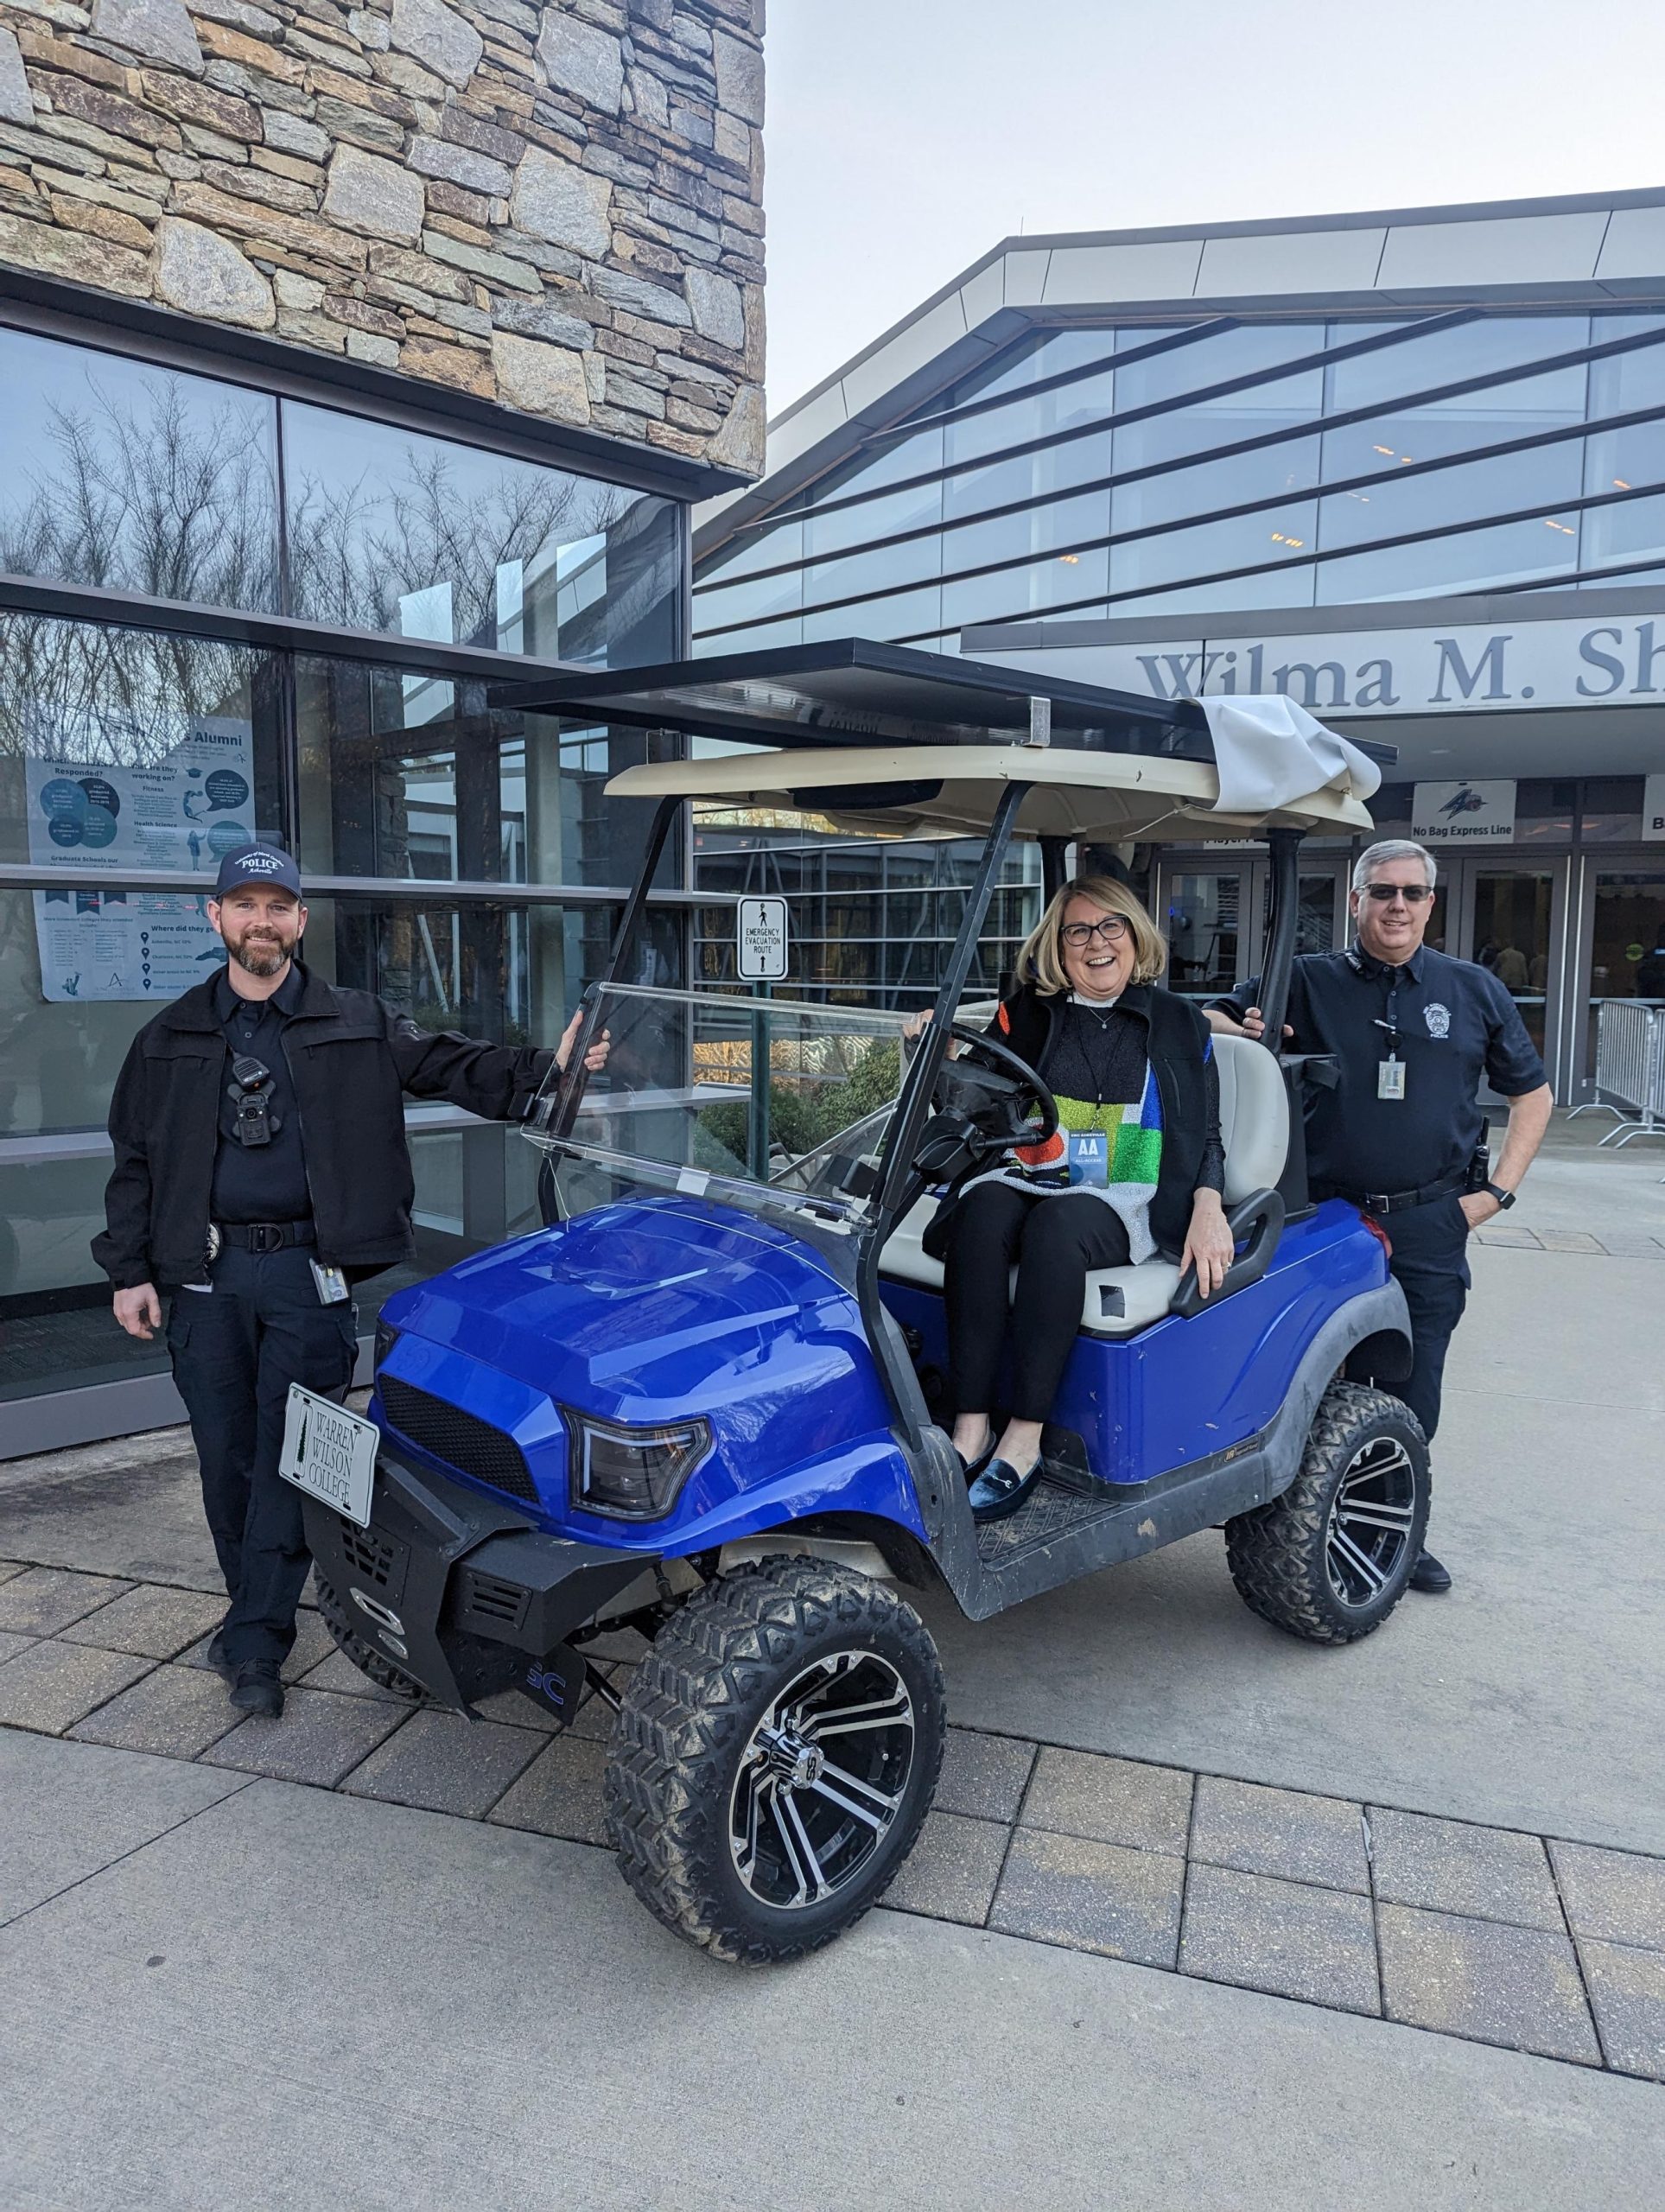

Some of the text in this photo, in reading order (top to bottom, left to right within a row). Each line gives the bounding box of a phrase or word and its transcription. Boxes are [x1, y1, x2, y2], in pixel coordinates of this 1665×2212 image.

[1136, 620, 1665, 707] Wilma M. Sh
[194, 731, 242, 746] Alumni
[54, 768, 103, 777] Responded?
[162, 765, 178, 773] they
[1413, 824, 1512, 837] No Bag Express Line
[242, 859, 278, 869] POLICE
[1078, 1139, 1098, 1155] AA
[317, 1411, 359, 1453] WARREN
[313, 1436, 353, 1478] WILSON
[308, 1462, 351, 1504] COLLEGE
